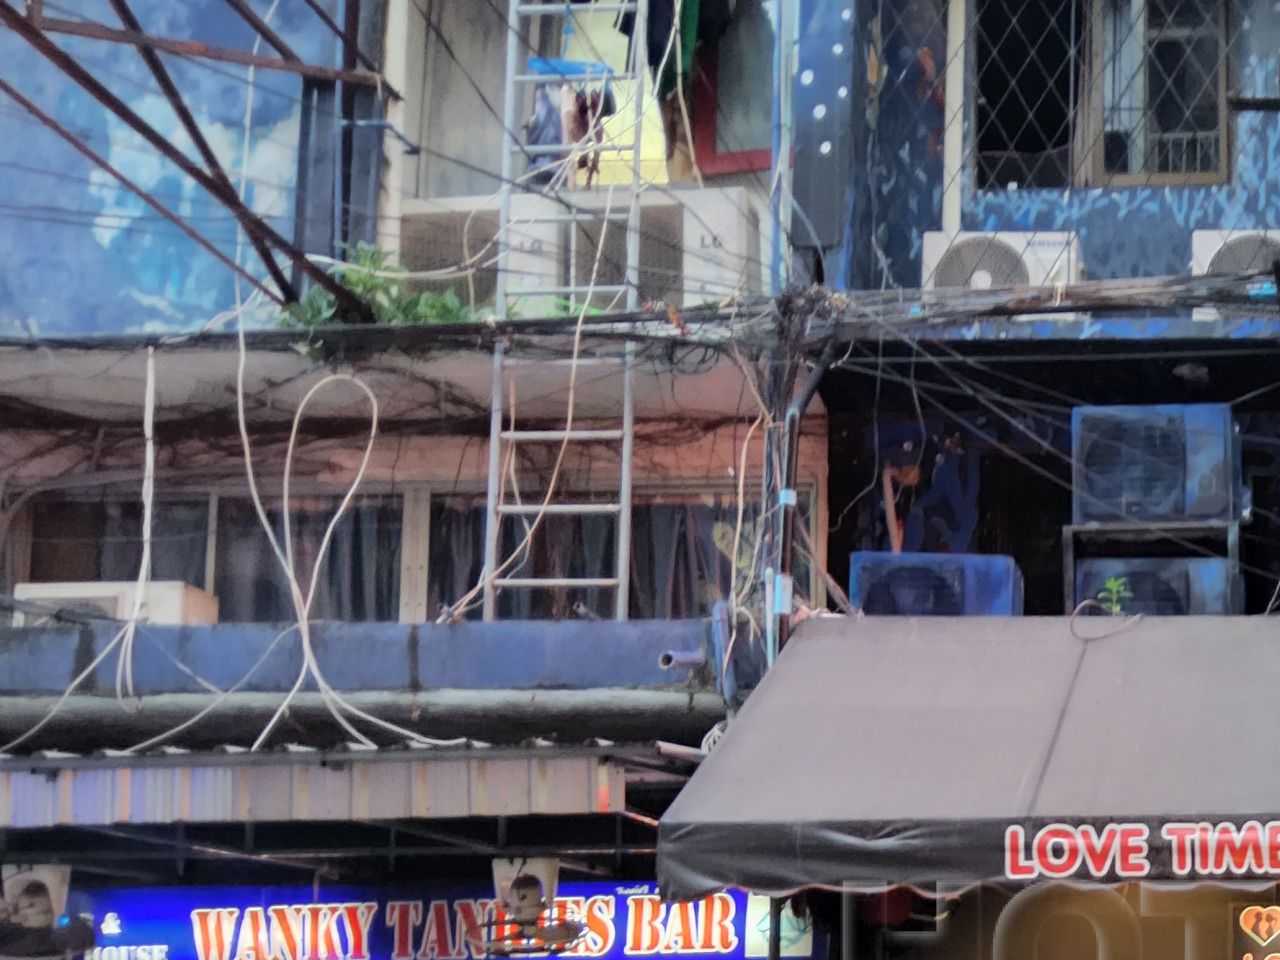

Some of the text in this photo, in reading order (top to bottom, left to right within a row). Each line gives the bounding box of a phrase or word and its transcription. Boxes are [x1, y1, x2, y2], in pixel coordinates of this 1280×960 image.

[1004, 823, 1150, 879] LOVE
[101, 912, 122, 934] &
[385, 896, 616, 960] TANES
[624, 885, 738, 956] BAR
